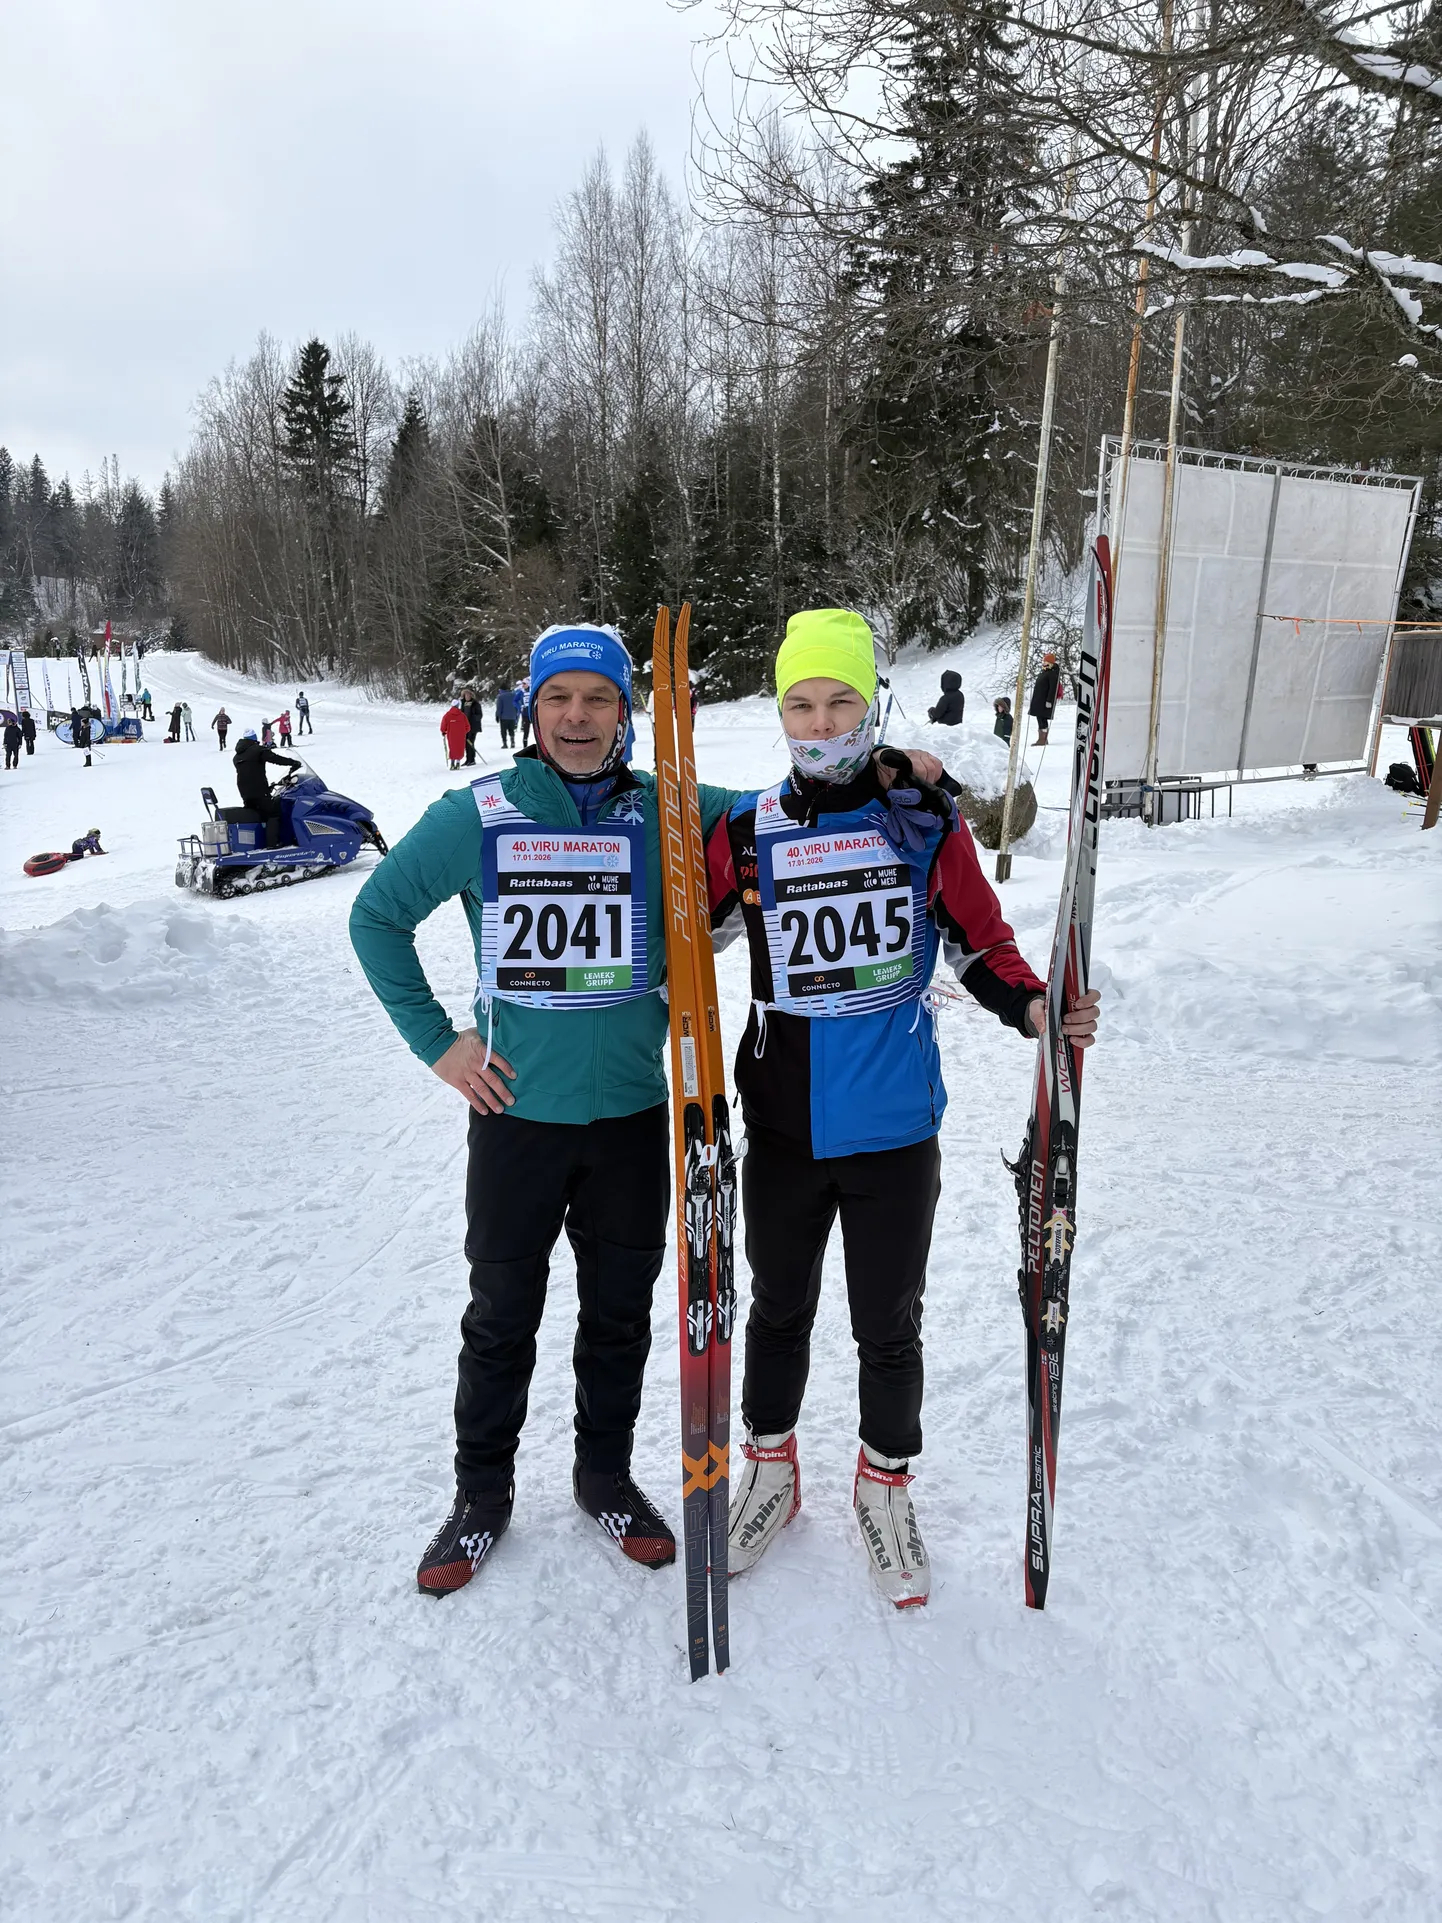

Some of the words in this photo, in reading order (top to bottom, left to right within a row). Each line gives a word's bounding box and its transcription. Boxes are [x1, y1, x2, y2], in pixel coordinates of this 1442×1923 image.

[541, 645, 558, 659] VIRU
[559, 641, 604, 652] MARATON
[512, 841, 531, 852] 40.
[532, 841, 560, 852] VIRU
[563, 842, 620, 853] MARATON
[662, 759, 691, 942] PELTONEN
[787, 846, 803, 858] 40.
[805, 842, 830, 856] VIRU
[834, 835, 886, 852] MARATO
[788, 856, 823, 867] 17.01.2026
[602, 875, 619, 883] MUHE
[878, 868, 897, 878] MUHE
[509, 879, 573, 888] Rattabaas
[603, 883, 618, 892] MESI
[786, 879, 849, 894] Rattabaas
[880, 877, 897, 886] MESI
[502, 903, 622, 960] 2041
[781, 896, 910, 966] 2045
[584, 971, 615, 980] LEMEKS
[872, 963, 902, 977] LEMEKS
[875, 969, 901, 982] GRUPP
[586, 979, 614, 987] GRUPP
[802, 981, 840, 992] CONNECTO
[1027, 1159, 1045, 1274] PELTONEN
[862, 1468, 893, 1482] alpina
[904, 1501, 924, 1567] alpin
[1031, 1492, 1044, 1573] SUPRA
